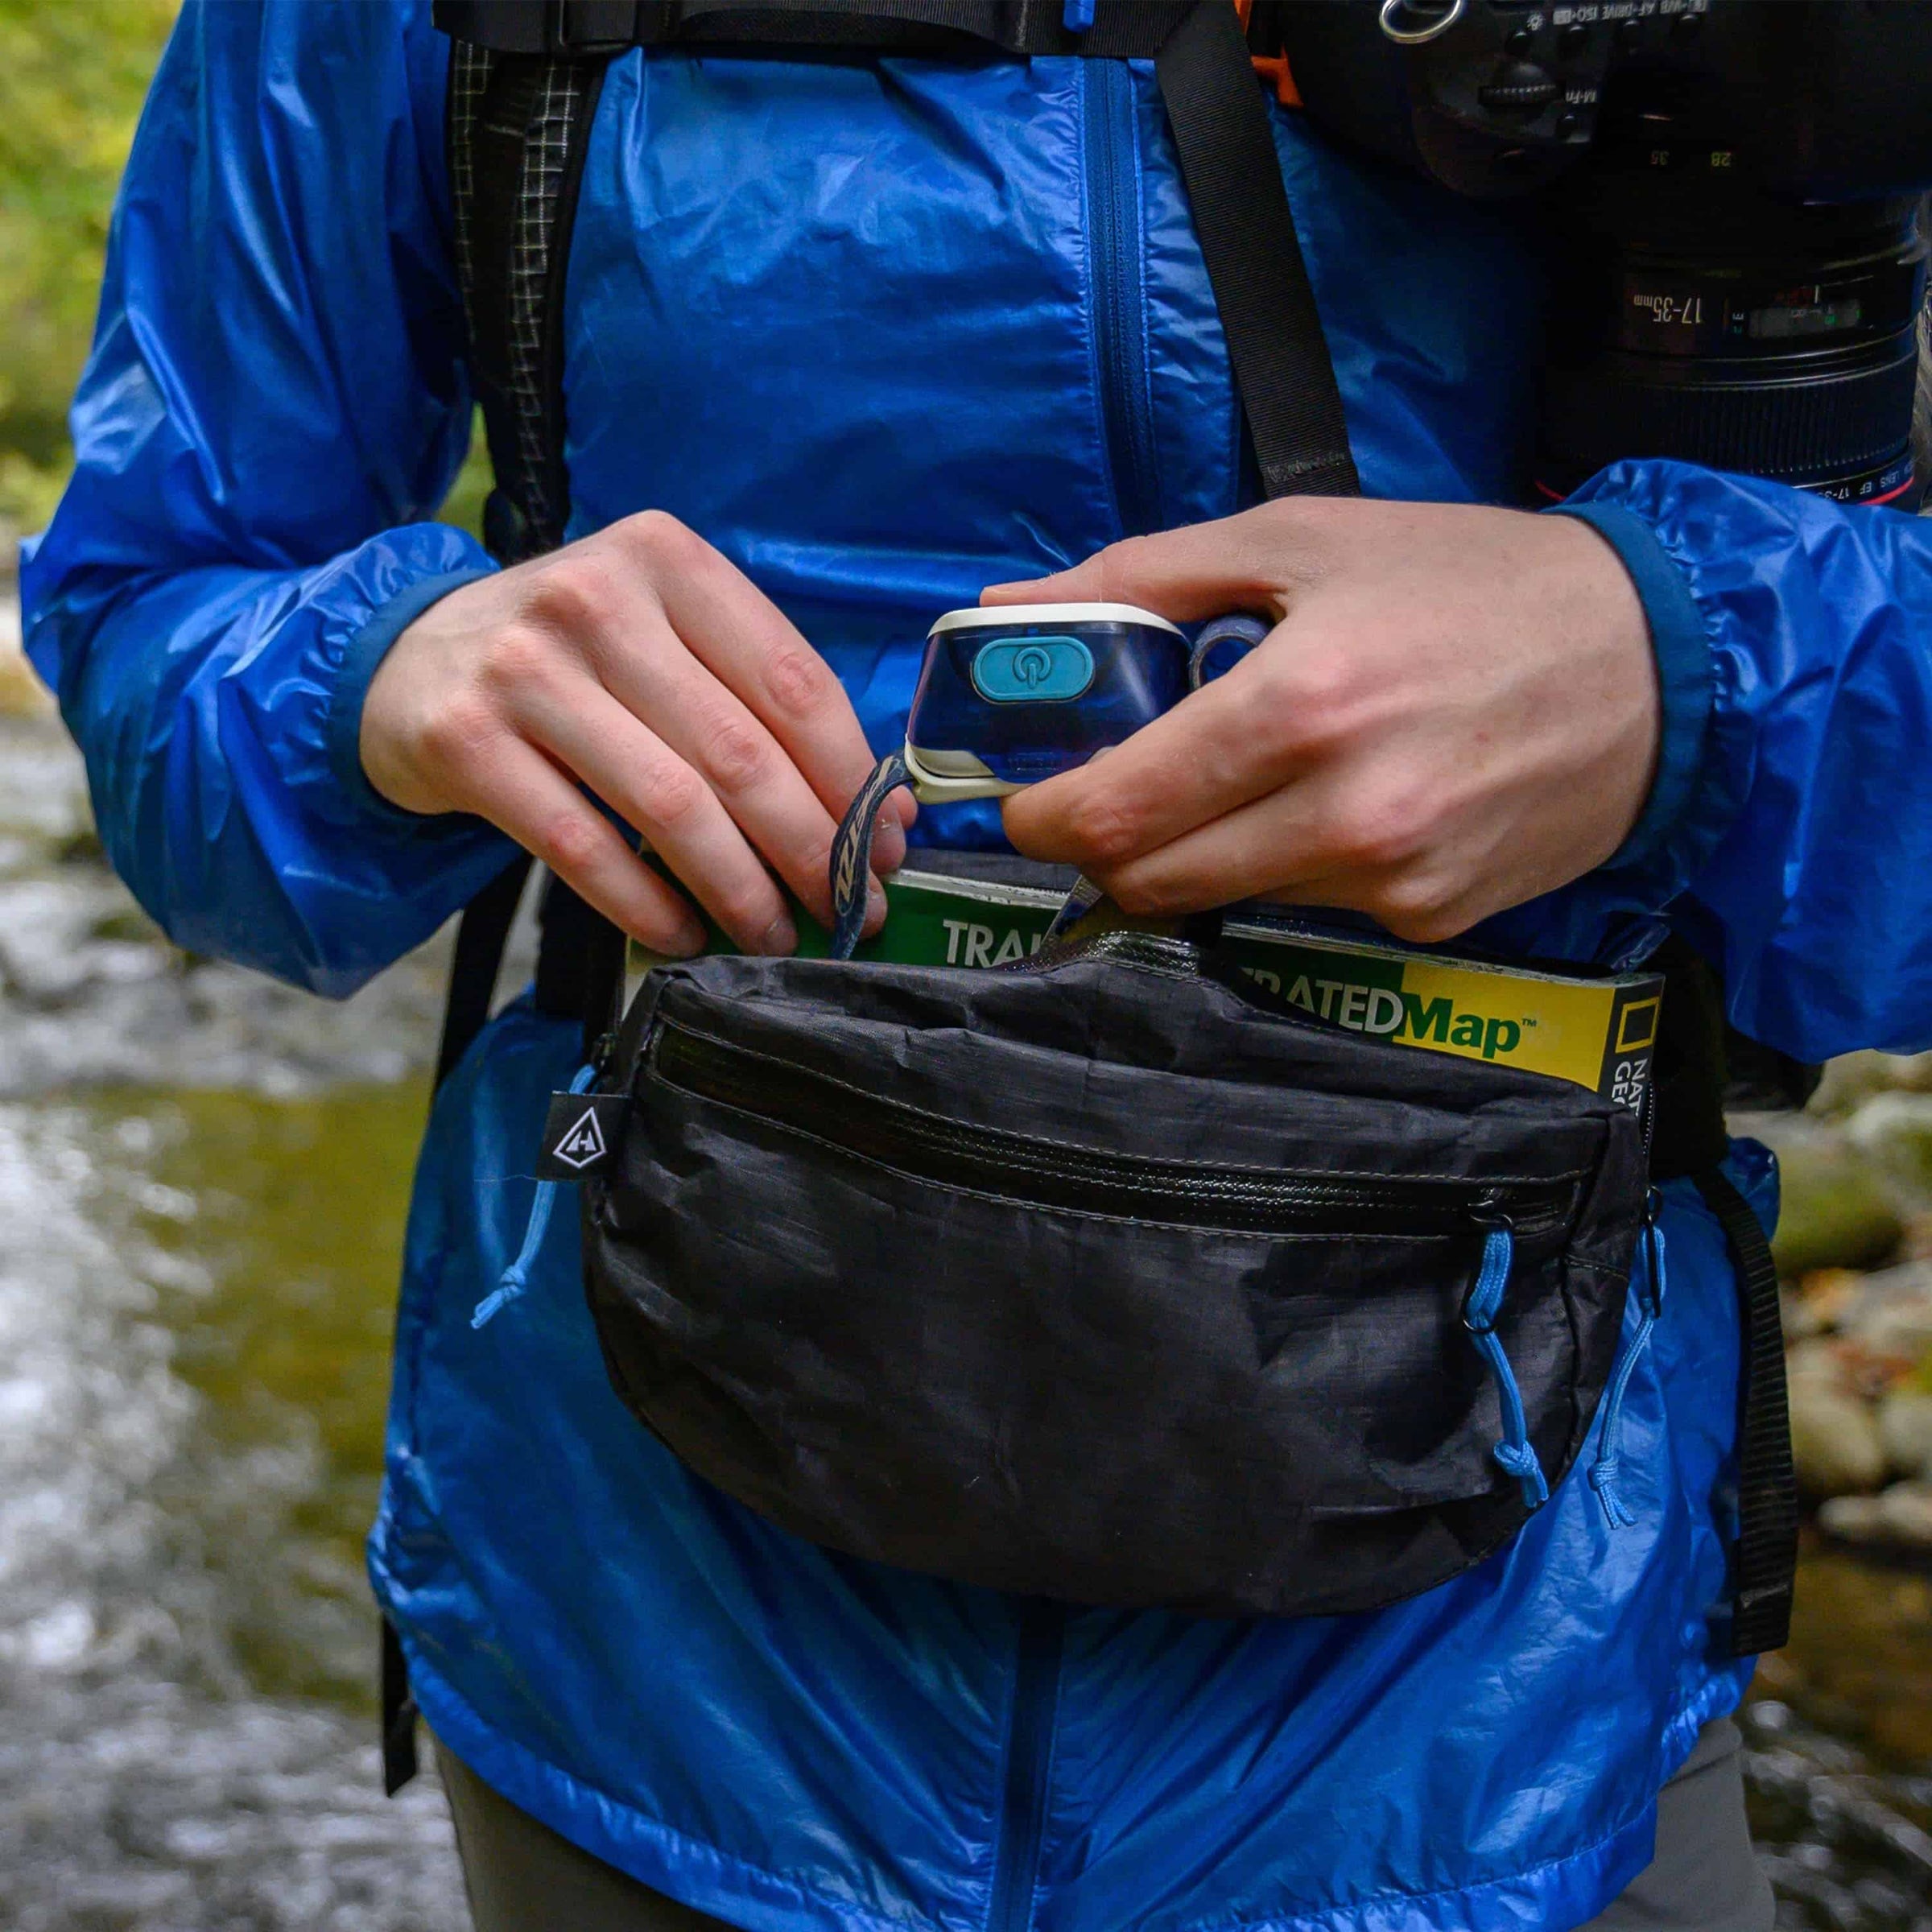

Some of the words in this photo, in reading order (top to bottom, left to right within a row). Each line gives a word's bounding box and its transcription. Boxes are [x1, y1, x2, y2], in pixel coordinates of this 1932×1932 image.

[1633, 294, 1702, 324] 17-35mm
[1817, 485, 1850, 501] 17-3
[1860, 481, 1872, 495] EF
